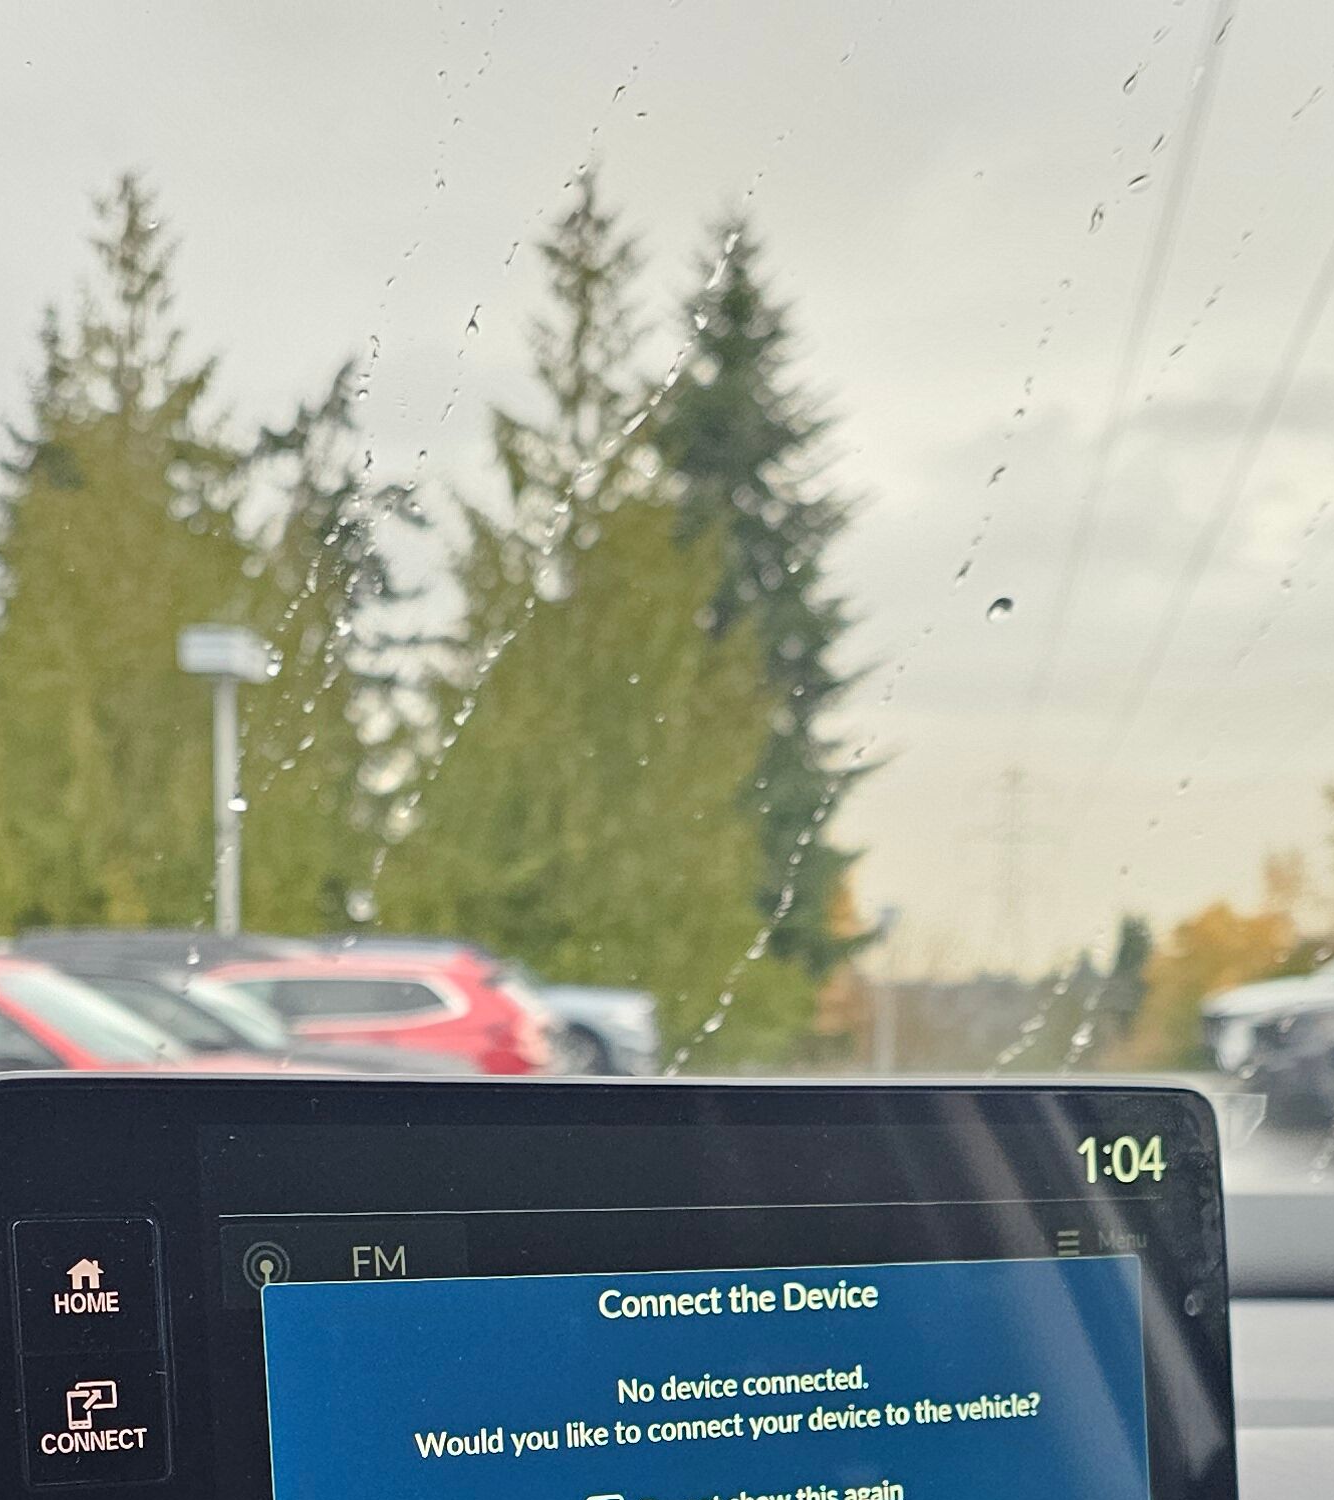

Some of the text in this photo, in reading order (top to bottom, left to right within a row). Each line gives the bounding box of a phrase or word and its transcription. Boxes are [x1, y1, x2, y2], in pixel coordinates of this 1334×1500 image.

[1077, 1134, 1166, 1184] 1:04
[1097, 1230, 1148, 1251] Menu
[352, 1245, 407, 1278] FM
[54, 1291, 120, 1314] HOME
[598, 1279, 879, 1319] Connect the Device
[617, 1364, 869, 1404] No device connected.
[41, 1428, 148, 1455] CONNECT
[414, 1392, 1041, 1459] Would you like to connect your device to the vehicle?
